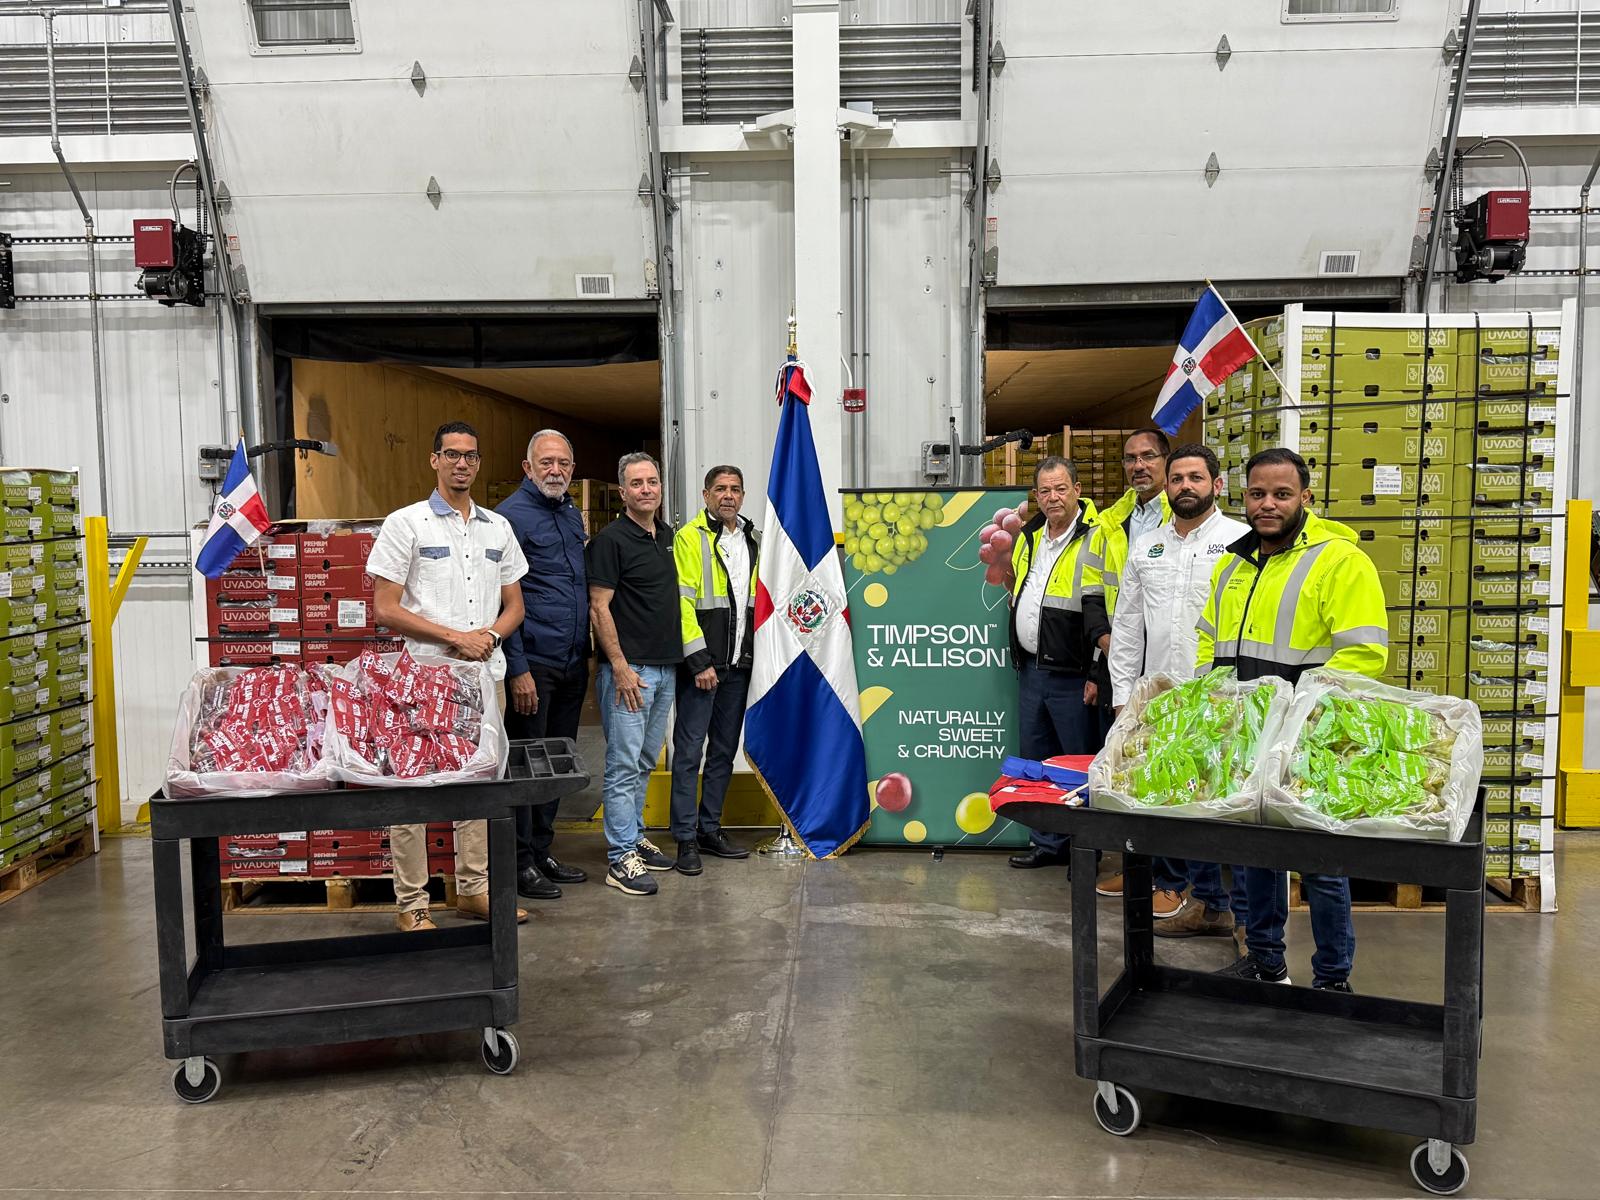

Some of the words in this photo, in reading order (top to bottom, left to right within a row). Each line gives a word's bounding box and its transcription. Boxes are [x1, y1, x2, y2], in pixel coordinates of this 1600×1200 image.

[223, 580, 268, 589] UVADOM
[223, 612, 270, 621] UVADOM
[225, 645, 272, 654] UVADOM
[867, 648, 883, 667] &
[899, 710, 1005, 726] NATURALLY
[939, 728, 1005, 742] SWEET
[898, 745, 909, 758] &
[914, 745, 1005, 759] CRUNCHY
[234, 860, 280, 869] UVADOM
